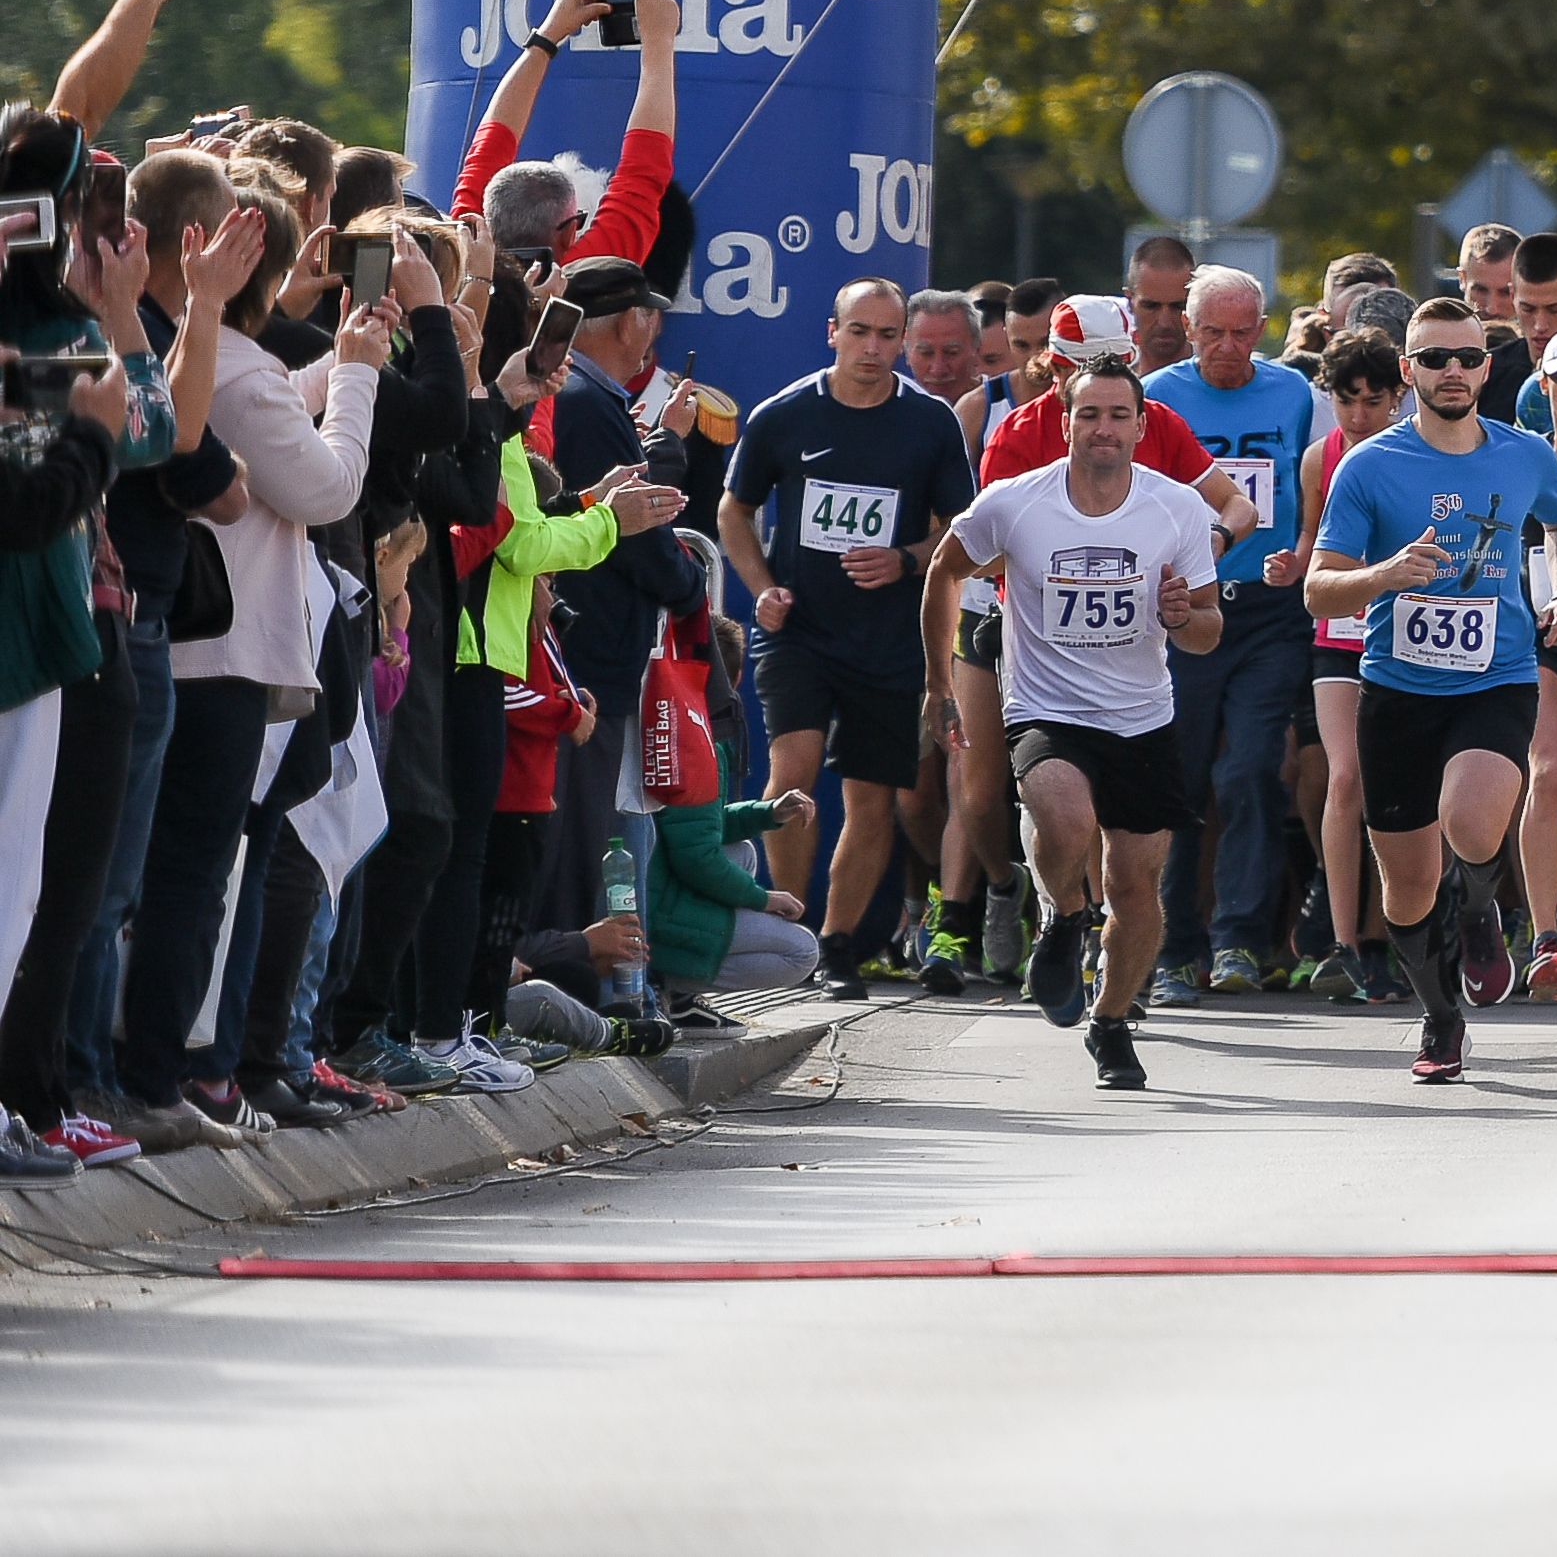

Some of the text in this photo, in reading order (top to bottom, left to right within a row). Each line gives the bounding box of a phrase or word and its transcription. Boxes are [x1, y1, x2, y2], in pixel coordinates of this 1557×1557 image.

[811, 494, 883, 537] 446
[1435, 533, 1461, 544] ount
[1057, 589, 1135, 629] 755
[1406, 607, 1484, 652] 638
[645, 727, 656, 786] CLEVER
[656, 700, 671, 786] LITTLE BAG
